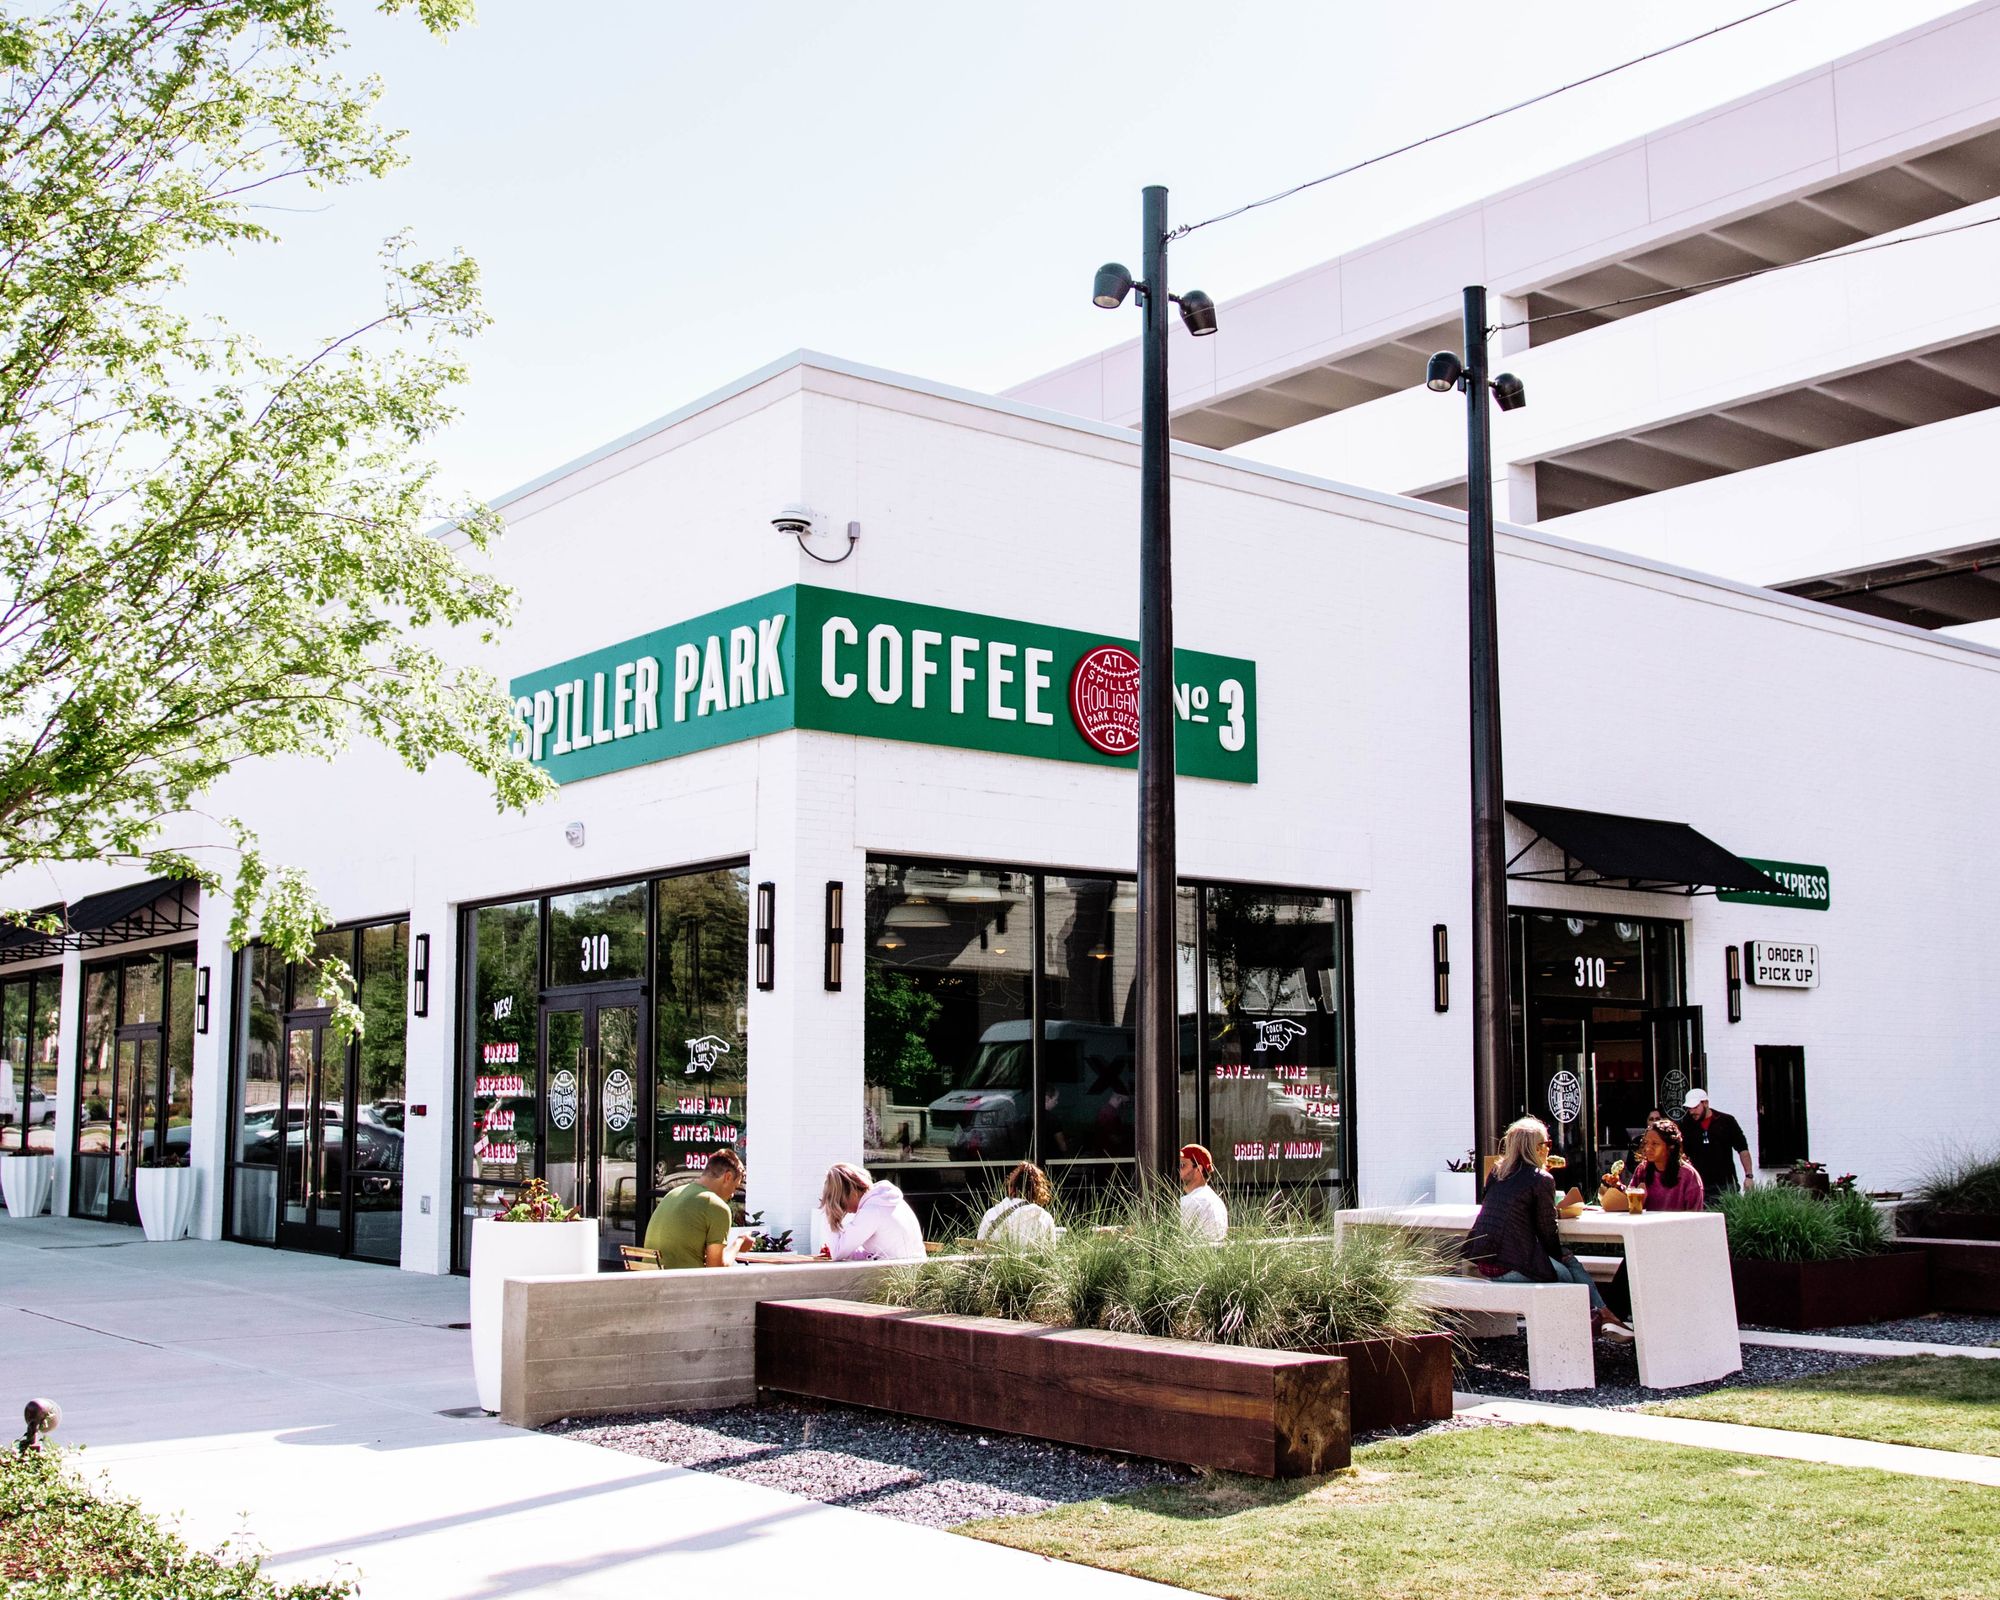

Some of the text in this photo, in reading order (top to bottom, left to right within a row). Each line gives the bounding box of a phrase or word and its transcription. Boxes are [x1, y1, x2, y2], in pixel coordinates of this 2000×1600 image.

[1102, 654, 1127, 669] ATL
[821, 616, 1054, 726] COFFEE
[513, 614, 786, 761] SPILLER PARK
[1088, 669, 1140, 692] SPILLER
[1082, 677, 1140, 717] HOOLIGAN
[1087, 711, 1140, 731] PARK COFFE
[1219, 679, 1246, 751] 3
[1105, 730, 1126, 745] GA
[581, 934, 610, 972] 310
[1768, 947, 1804, 963] ORDER
[1574, 956, 1605, 988] 310
[1759, 966, 1813, 982] PICK UP
[493, 996, 513, 1021] YES!
[1266, 1024, 1283, 1034] COACH
[483, 1042, 519, 1063] COFFEE
[695, 1041, 710, 1053] COACH
[613, 1073, 623, 1081] ATL
[1215, 1064, 1308, 1079] SAVE... TIME
[1560, 1073, 1570, 1081] ATL
[476, 1075, 524, 1097] ESPRESSO
[1282, 1084, 1330, 1098] MONEY
[678, 1096, 731, 1114] THIS WAY
[1306, 1102, 1340, 1117] FACE
[484, 1109, 515, 1130] TOAST
[560, 1117, 568, 1126] GA
[613, 1119, 622, 1127] GA
[1561, 1112, 1570, 1120] GA
[672, 1125, 737, 1142] ENTER AND
[481, 1142, 517, 1164] BAGELS
[1234, 1141, 1323, 1160] ORDER AT WINDOW
[685, 1152, 712, 1169] ORD
